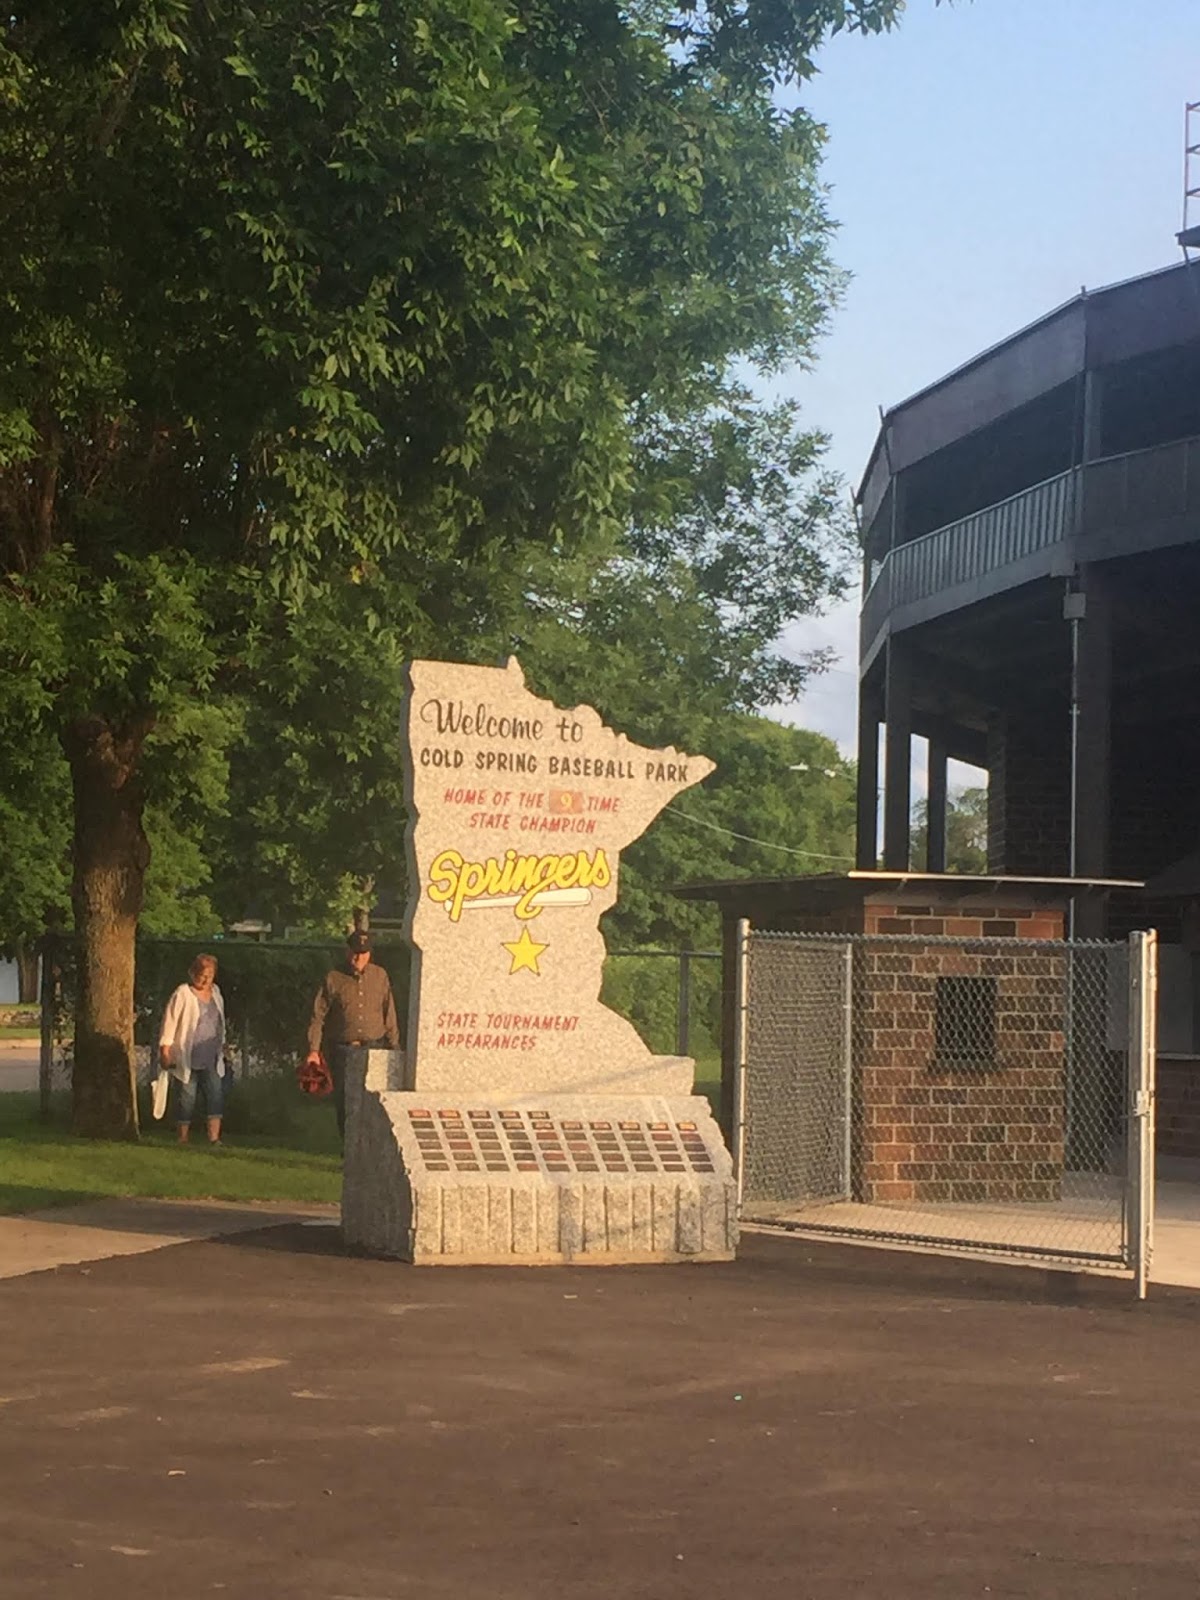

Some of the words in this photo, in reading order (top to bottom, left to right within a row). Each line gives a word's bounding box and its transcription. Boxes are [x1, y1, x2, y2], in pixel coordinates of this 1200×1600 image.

[420, 699, 543, 740] Welcome
[556, 717, 582, 742] to
[420, 748, 463, 768] COLD
[475, 752, 537, 773] SPRING
[549, 756, 634, 779] BASEBALL
[646, 762, 688, 782] PARK
[444, 788, 486, 804] HOME
[493, 791, 512, 806] OF
[520, 792, 544, 808] THE
[588, 796, 620, 812] TIME
[470, 812, 511, 830] STATE
[520, 815, 597, 833] CHAMPION
[427, 848, 611, 923] Springers
[437, 1012, 478, 1028] STATE
[486, 1013, 579, 1031] TOURNAMENT
[437, 1033, 537, 1050] APPEARANCES
